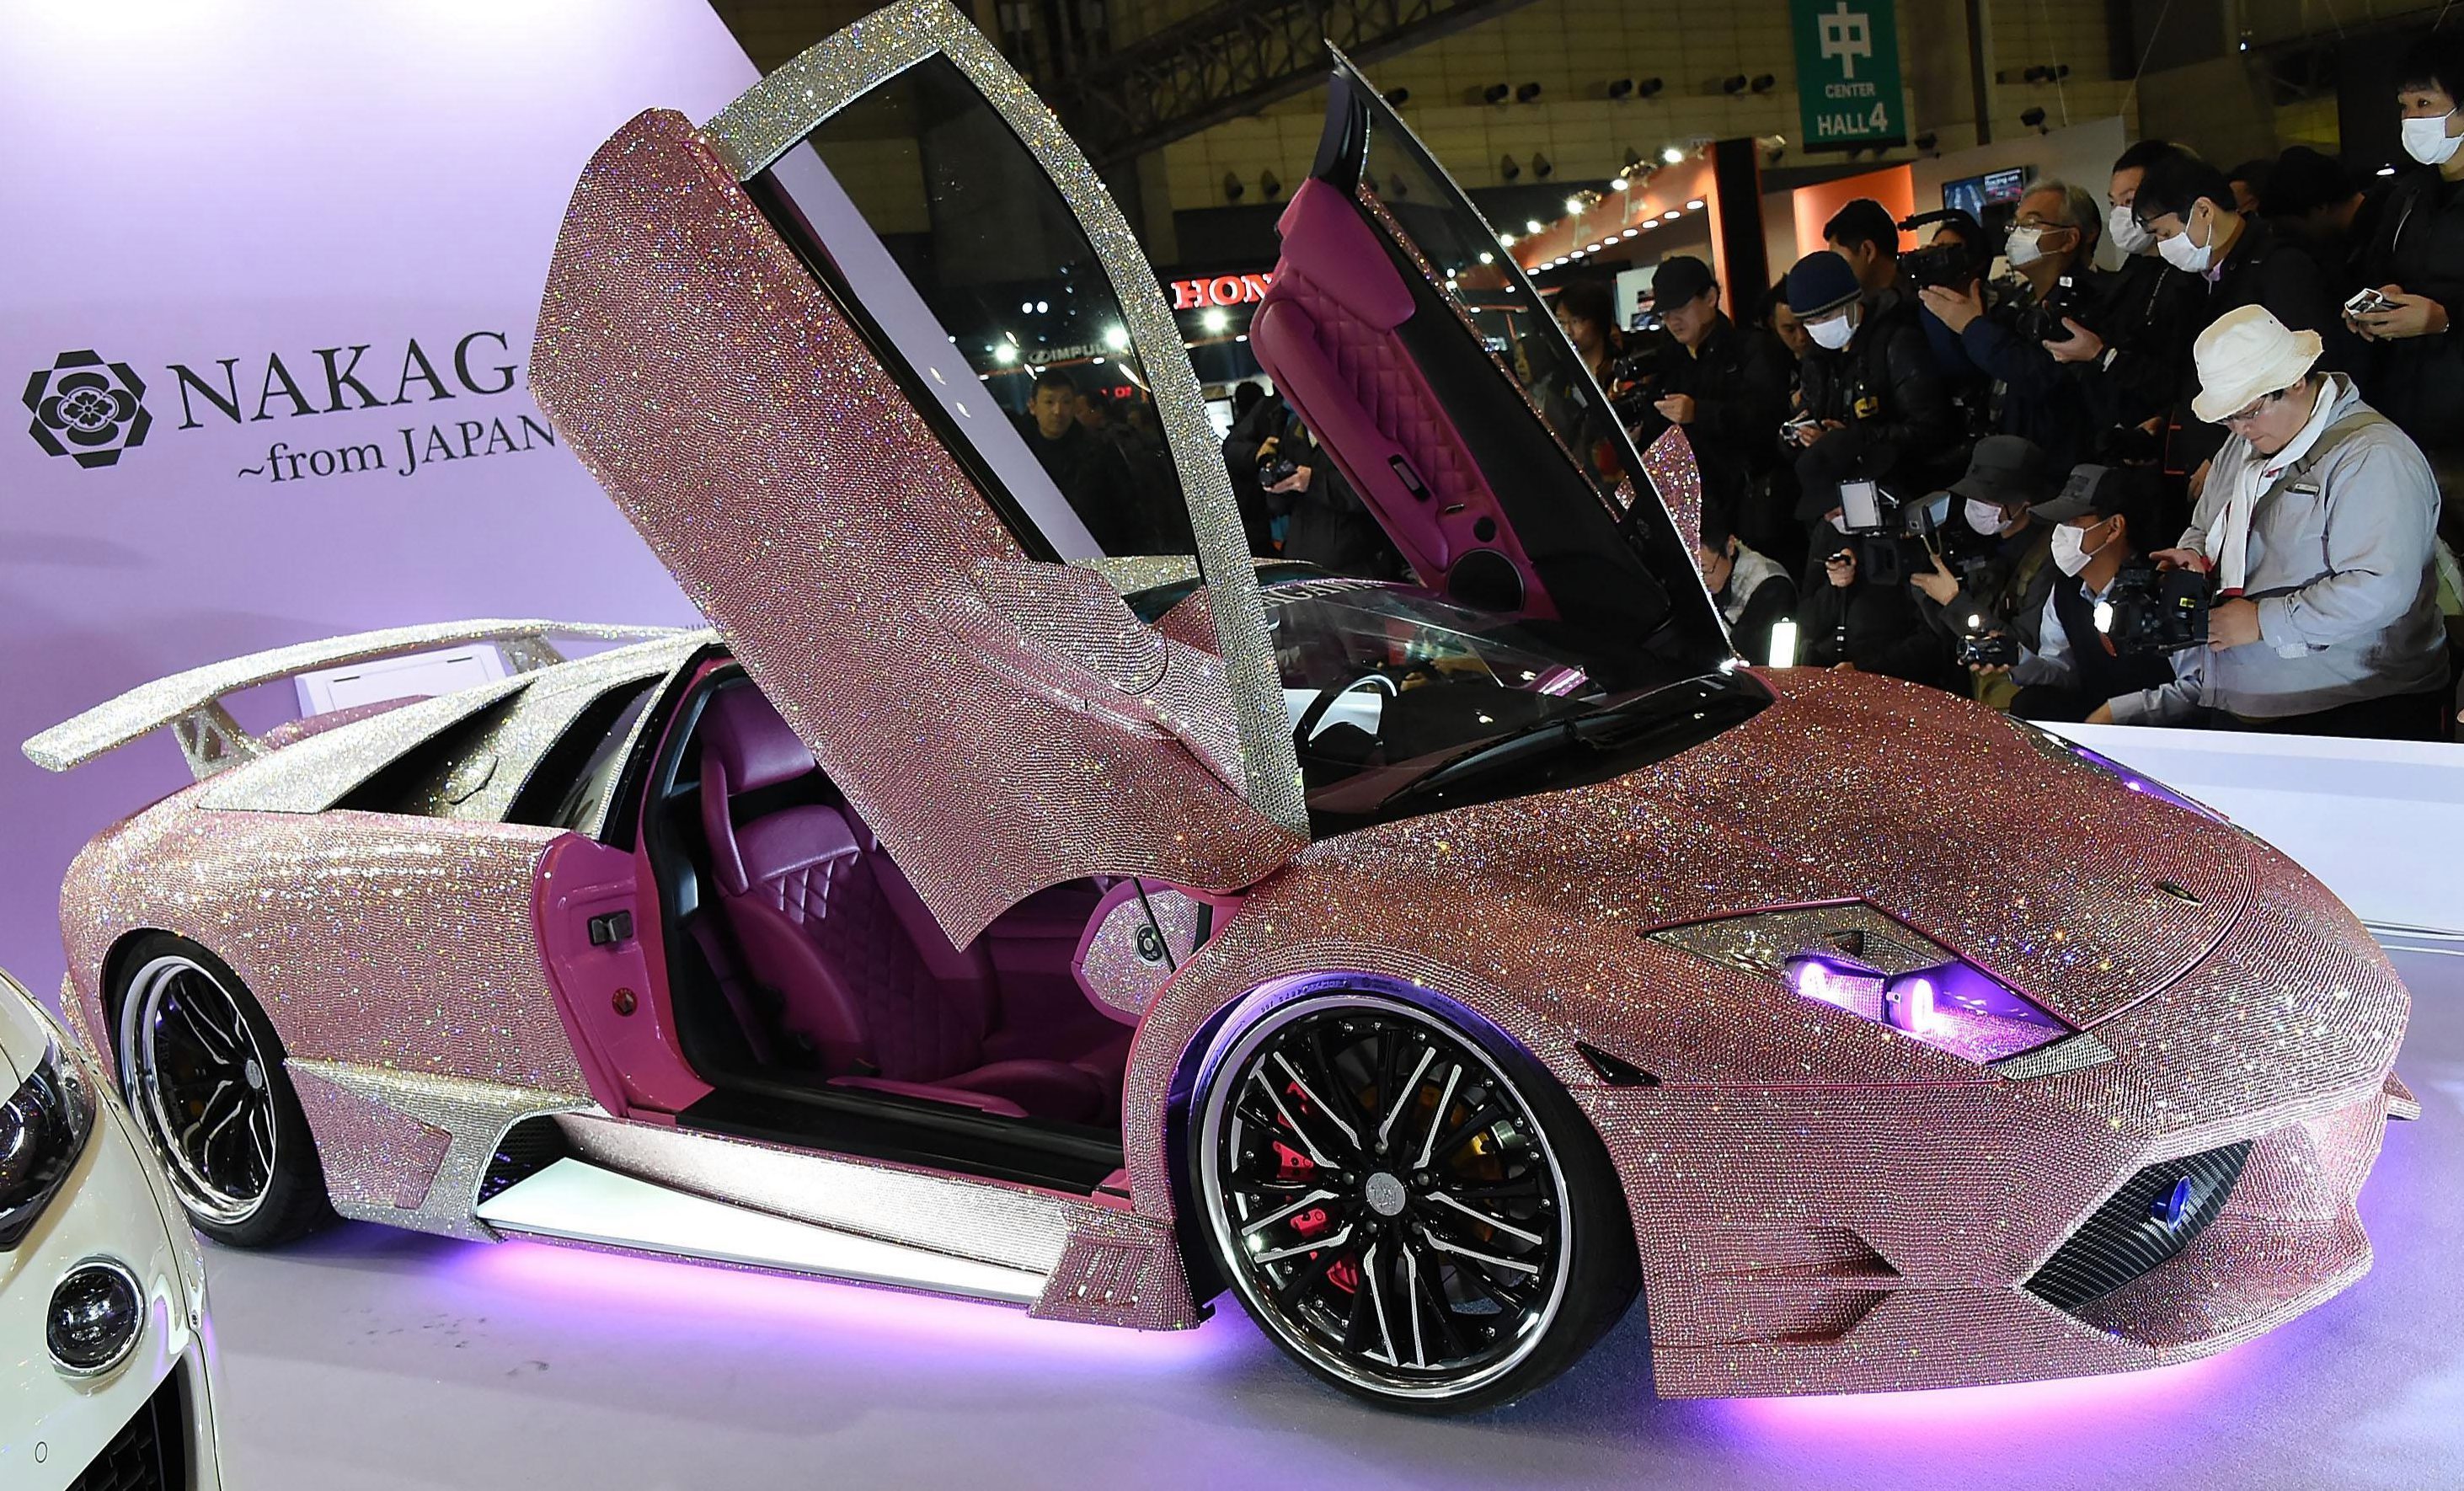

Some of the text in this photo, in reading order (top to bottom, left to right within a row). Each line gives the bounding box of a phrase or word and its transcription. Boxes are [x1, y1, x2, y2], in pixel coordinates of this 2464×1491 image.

[1817, 2, 1871, 78] 中
[1825, 82, 1875, 99] CENTER
[166, 332, 528, 430] NAKAG
[399, 414, 556, 476] JAPAN
